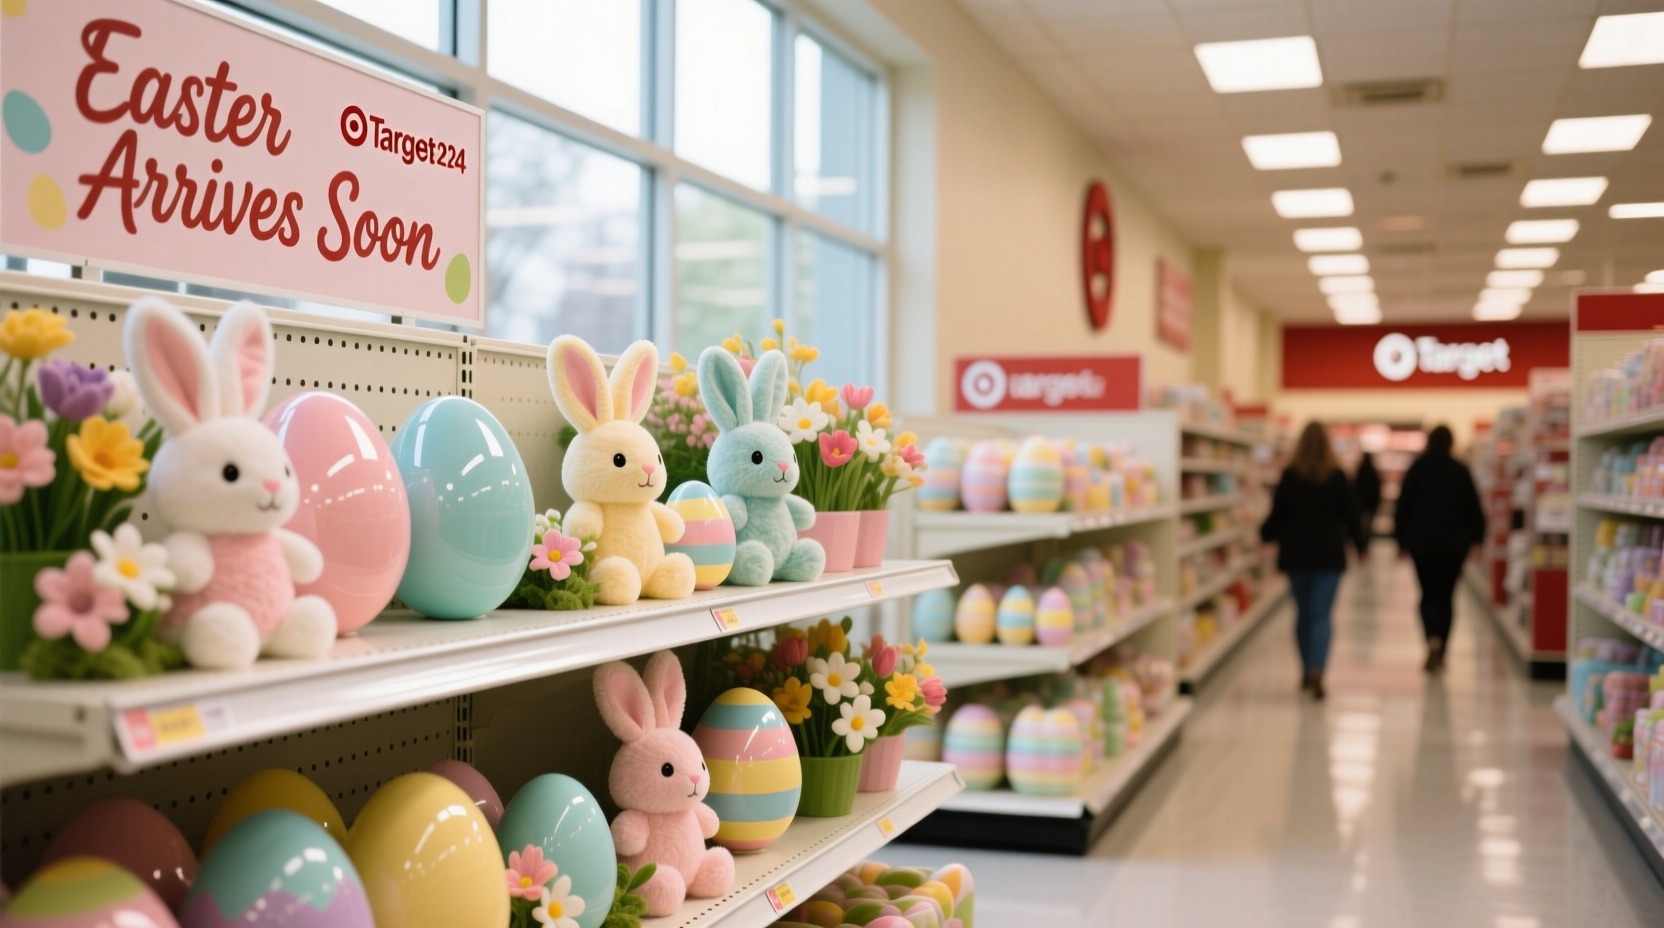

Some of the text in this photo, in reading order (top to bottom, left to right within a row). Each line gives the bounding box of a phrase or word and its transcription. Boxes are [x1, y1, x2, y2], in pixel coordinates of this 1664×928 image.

[75, 18, 291, 155] Easter
[370, 115, 467, 174] Target224
[78, 129, 440, 270] Arrives Soon
